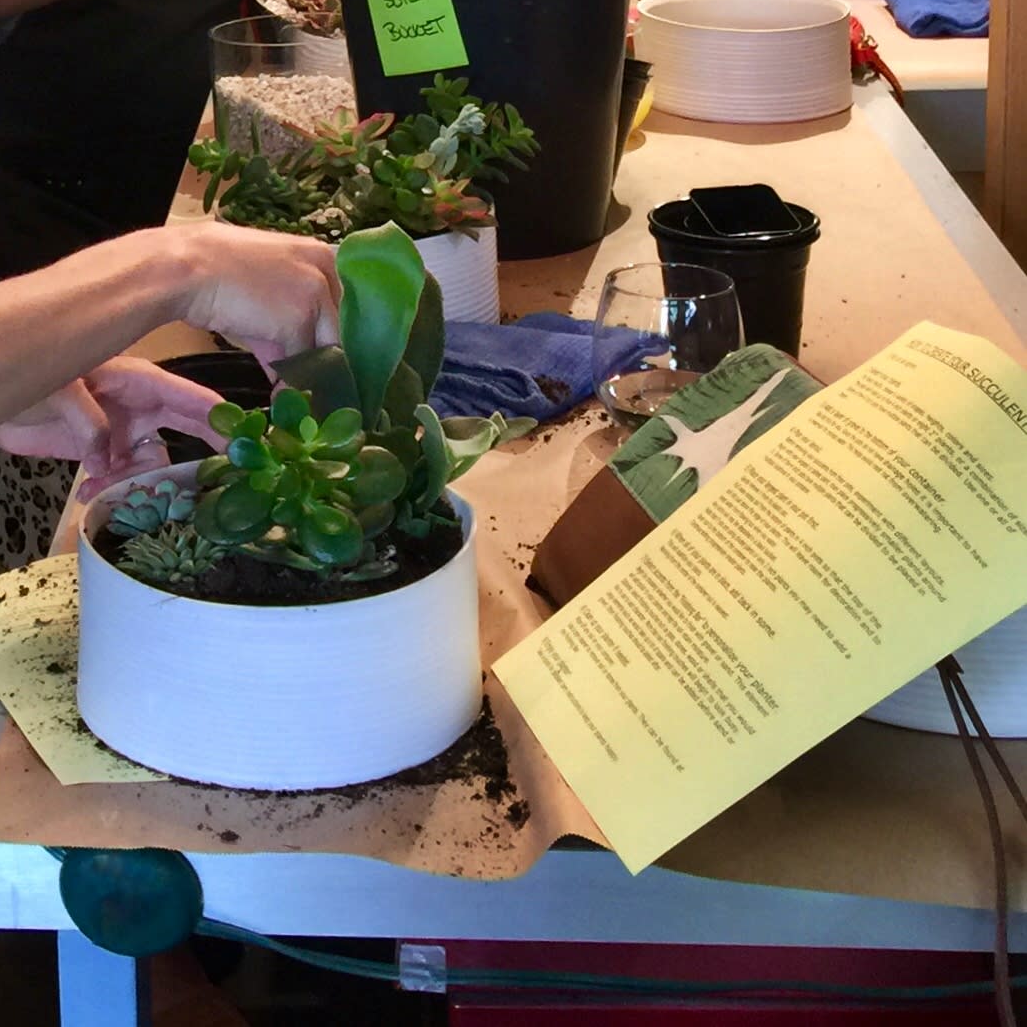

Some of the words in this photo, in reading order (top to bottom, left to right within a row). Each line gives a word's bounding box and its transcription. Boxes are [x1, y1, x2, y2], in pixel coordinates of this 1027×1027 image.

[962, 448, 977, 464] and
[975, 492, 989, 506] one
[988, 506, 998, 516] or
[996, 514, 1007, 525] all
[1005, 524, 1016, 535] of
[1007, 510, 1017, 521] of
[894, 529, 921, 559] different
[931, 508, 963, 542] important
[961, 541, 970, 550] to
[969, 549, 988, 568] have
[887, 554, 897, 565] be
[896, 564, 918, 588] placed
[921, 576, 946, 603] around
[840, 583, 853, 596] the
[850, 595, 863, 609] top
[862, 606, 872, 617] of
[869, 615, 882, 629] the
[810, 613, 827, 631] need
[825, 629, 834, 639] to
[832, 637, 847, 653] add
[735, 661, 754, 681] your
[725, 701, 738, 715] you
[734, 676, 748, 690] This
[744, 690, 770, 717] element
